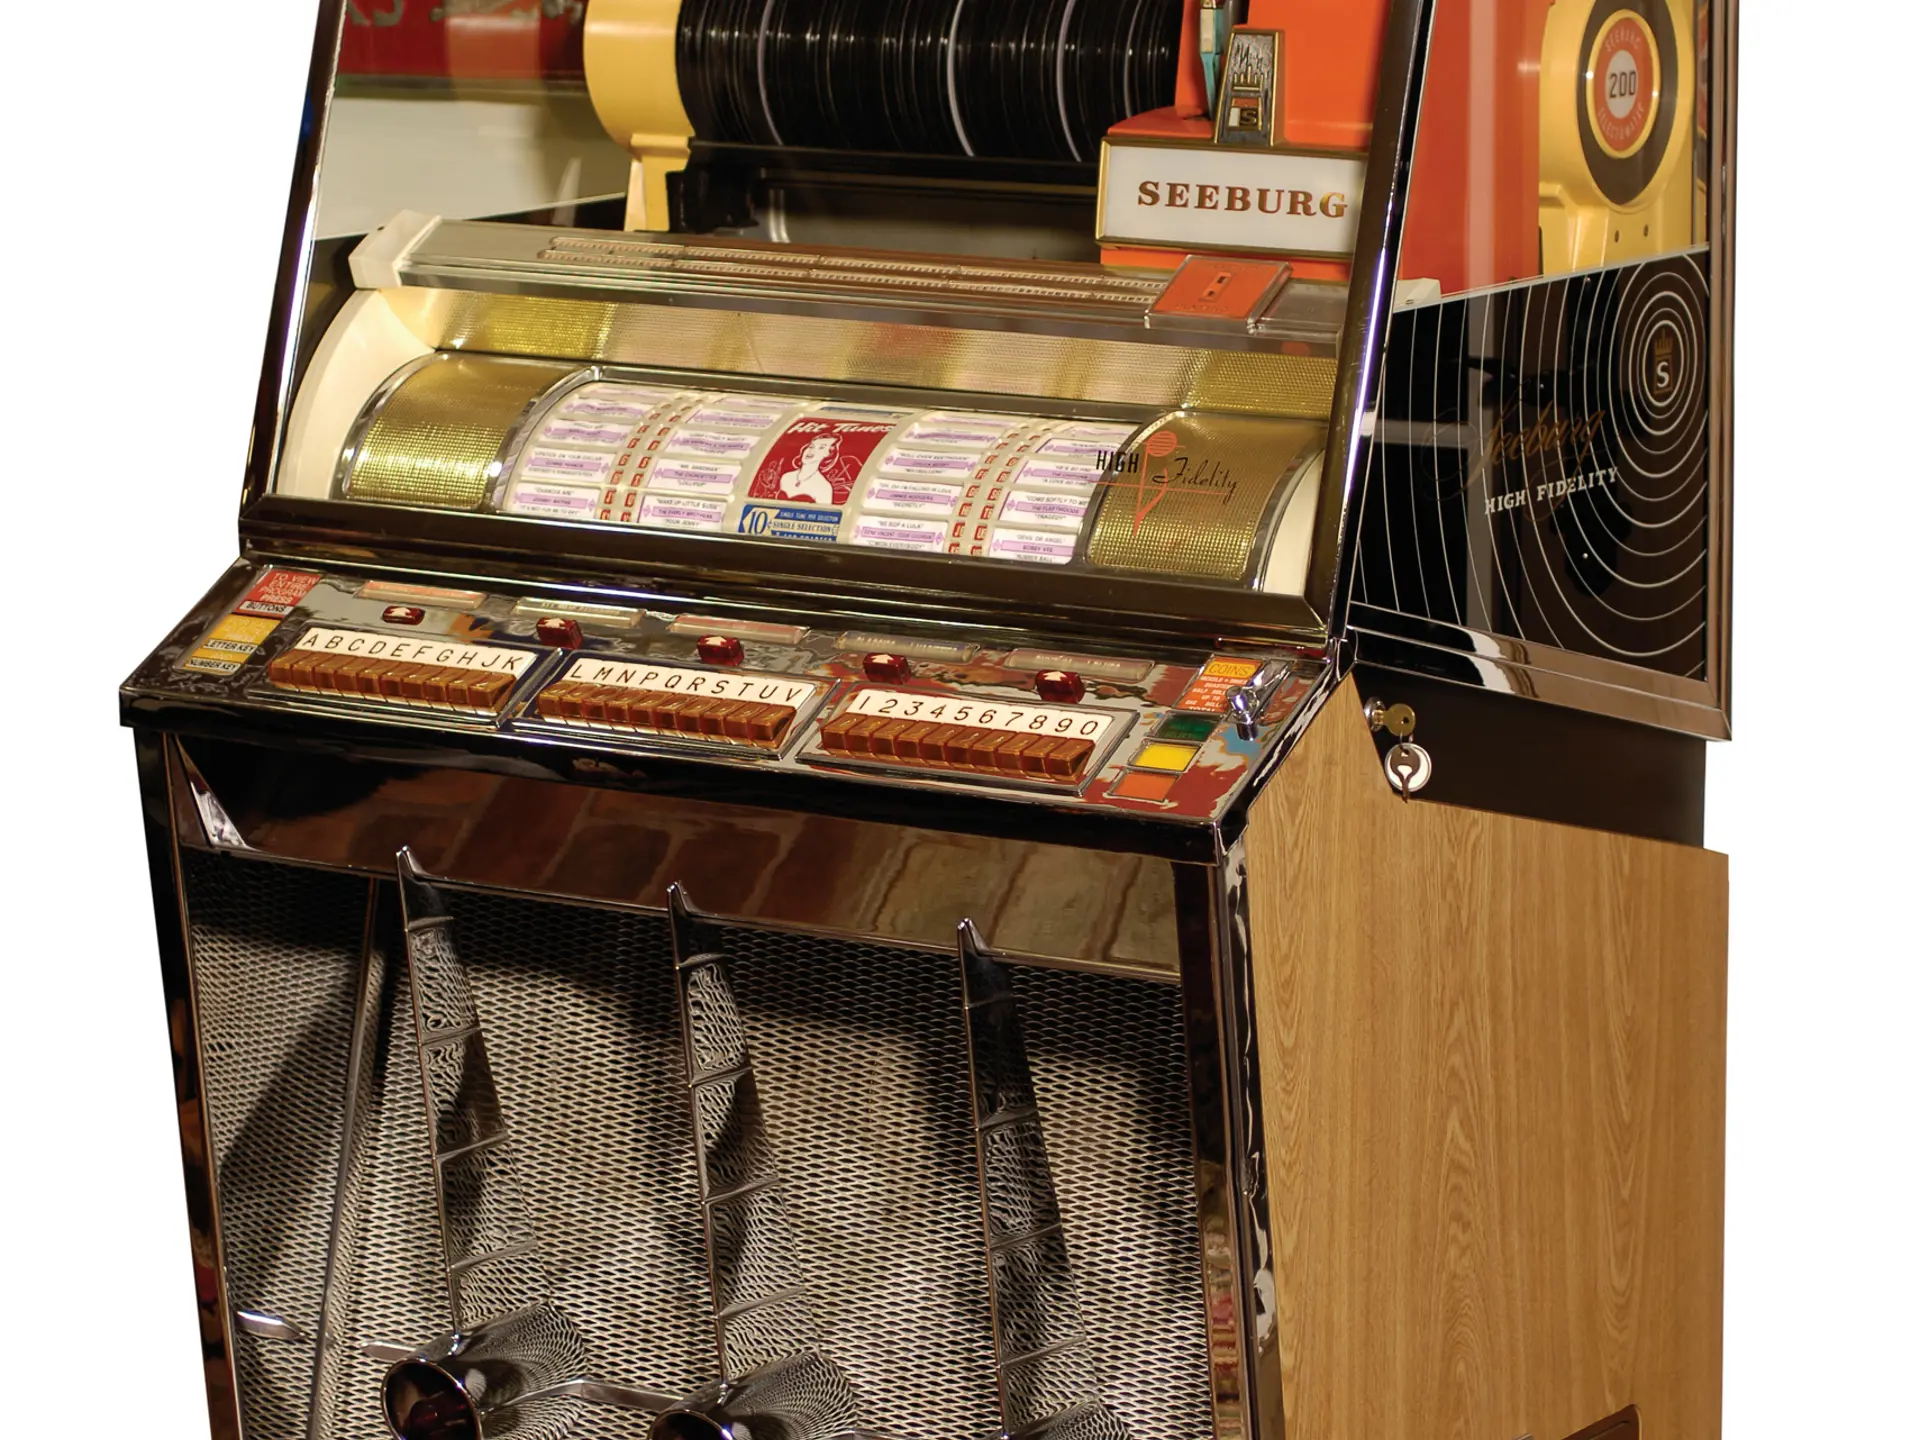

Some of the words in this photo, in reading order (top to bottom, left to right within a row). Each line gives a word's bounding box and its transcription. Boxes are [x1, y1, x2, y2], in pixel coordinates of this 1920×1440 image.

[1609, 70, 1637, 99] 200
[1240, 108, 1258, 126] S
[1137, 180, 1348, 218] SEEBURG
[1656, 361, 1669, 388] S
[832, 422, 896, 434] Tunes
[1096, 450, 1139, 473] HIGH
[1152, 456, 1237, 504] Fidelity
[1484, 489, 1528, 515] HIGH
[1536, 467, 1620, 501] FIDELITY
[772, 521, 795, 530] SINGLE
[797, 523, 833, 533] SELECTION
[246, 601, 287, 613] BUTTONS
[204, 639, 237, 650] LETTER
[236, 643, 257, 653] KEY
[190, 658, 222, 669] NUMBER
[221, 662, 241, 671] KEY
[1208, 663, 1250, 677] COINS
